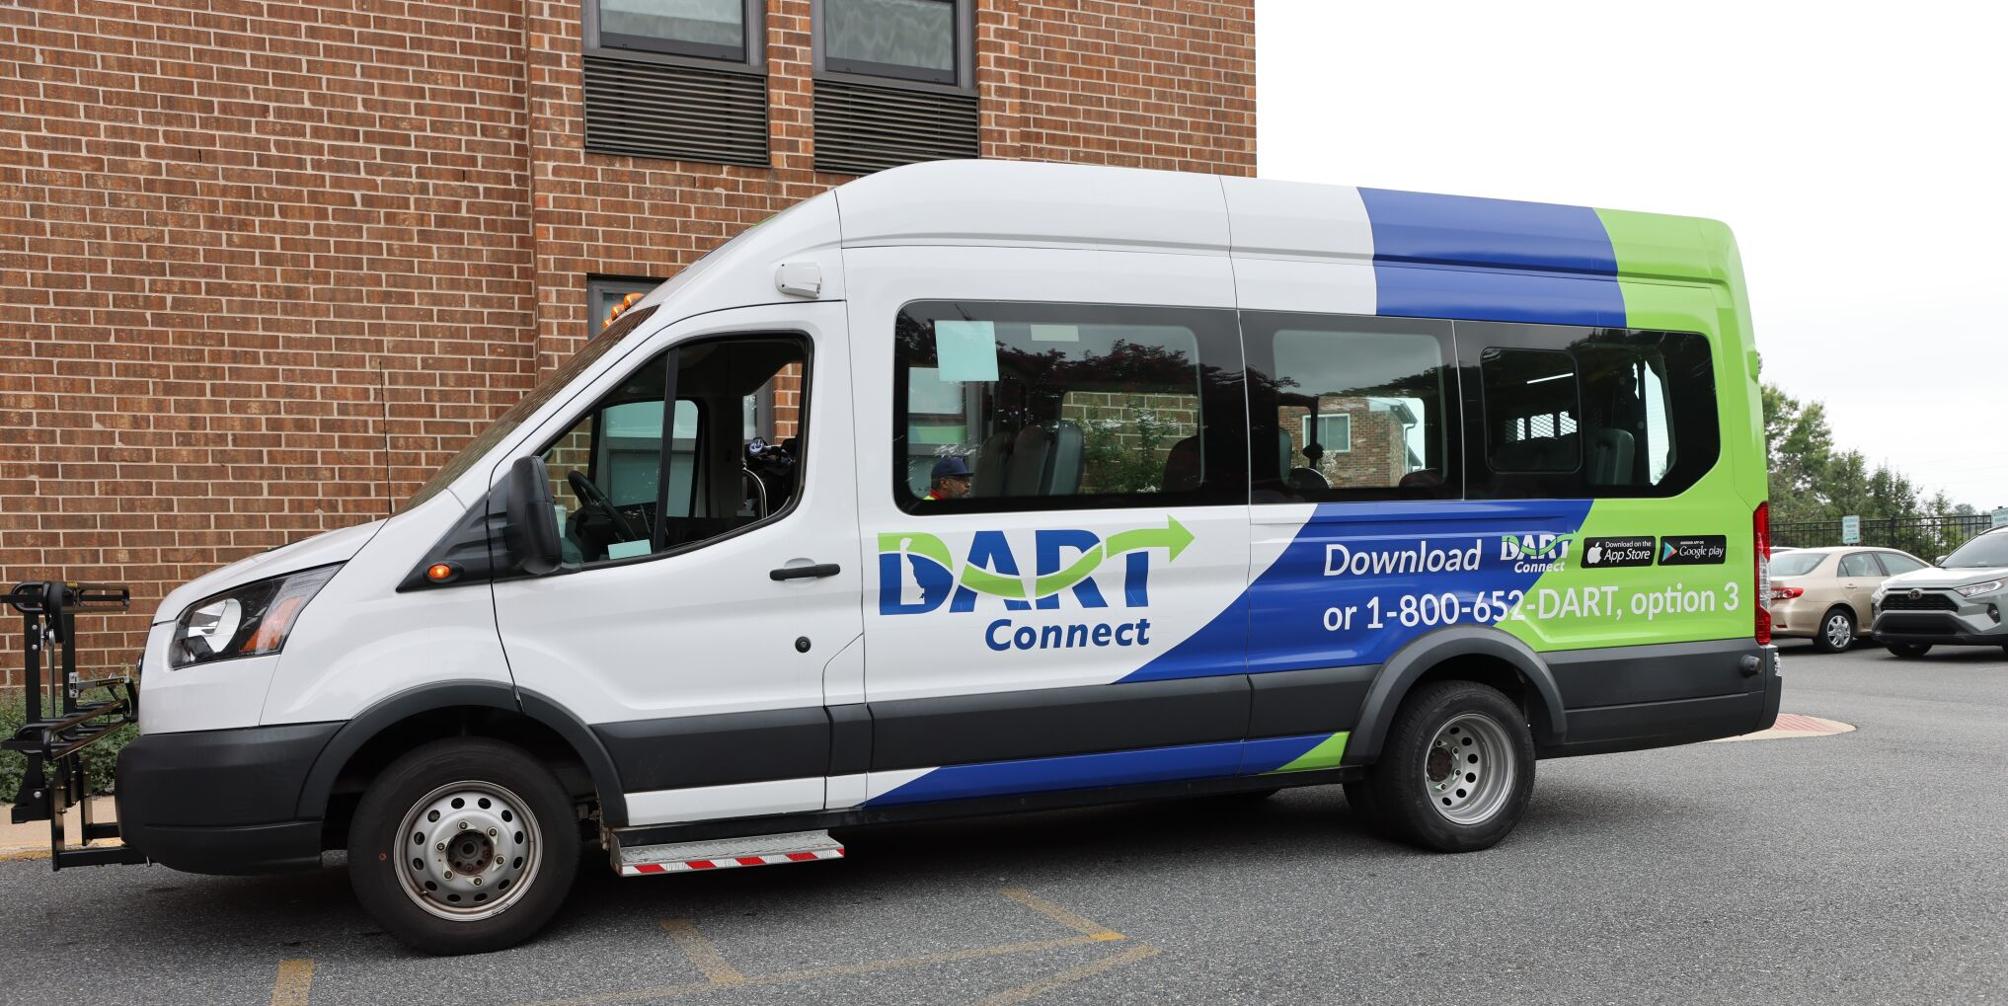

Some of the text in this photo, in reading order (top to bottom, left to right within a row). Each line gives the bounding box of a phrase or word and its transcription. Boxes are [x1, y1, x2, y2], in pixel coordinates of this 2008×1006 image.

[1324, 539, 1482, 576] Download
[1500, 531, 1578, 560] DART
[1603, 548, 1651, 563] App Store
[1679, 545, 1724, 559] Google play
[877, 514, 1195, 615] DART
[1514, 561, 1566, 573] Connect
[1323, 581, 1739, 631] or 1-800-652-DART, option 3
[985, 618, 1150, 652] Connect
